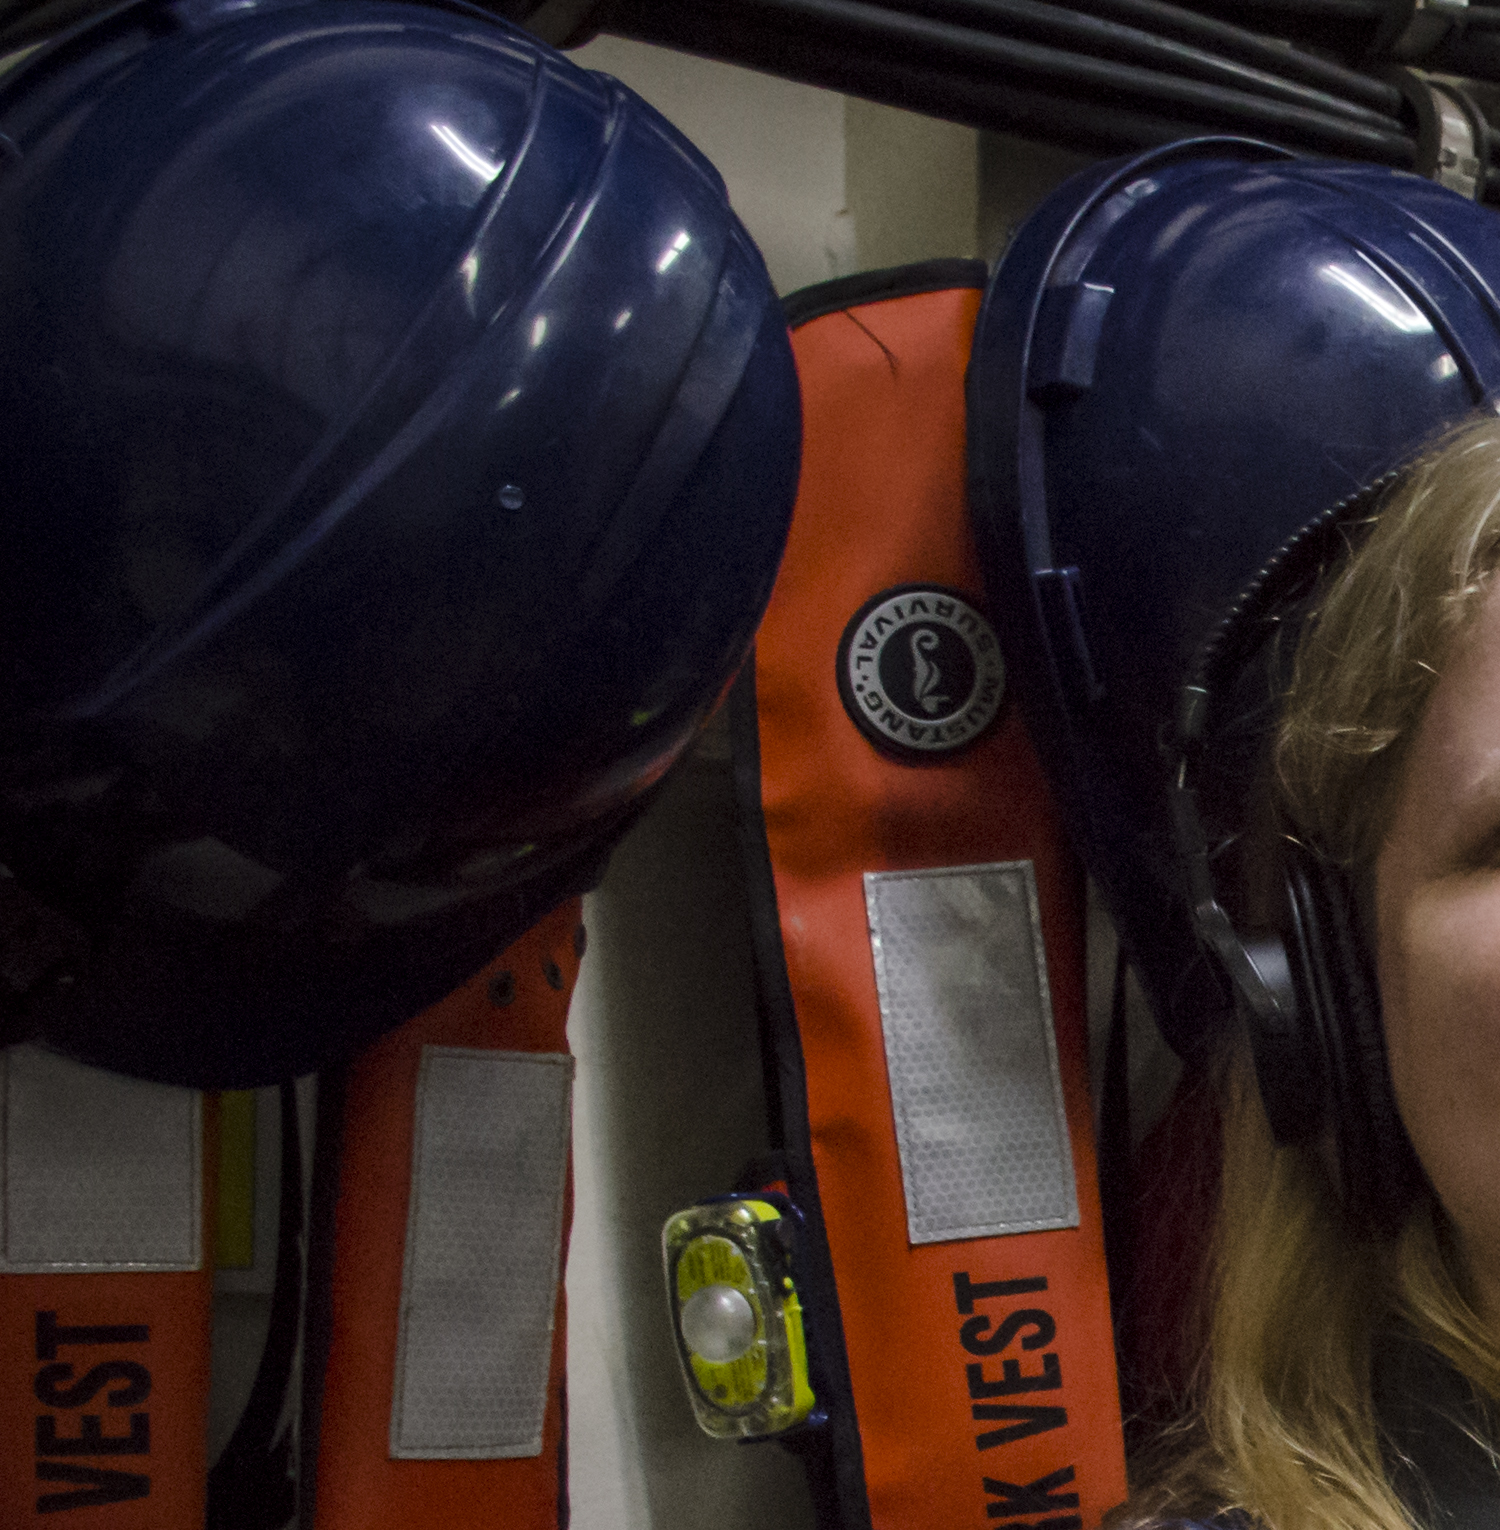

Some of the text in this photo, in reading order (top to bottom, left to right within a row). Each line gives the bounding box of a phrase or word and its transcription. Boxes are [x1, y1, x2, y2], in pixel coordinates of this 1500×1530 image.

[856, 599, 995, 670] SURVIVAL
[33, 1310, 152, 1515] VEST
[953, 1271, 1069, 1452] VEST
